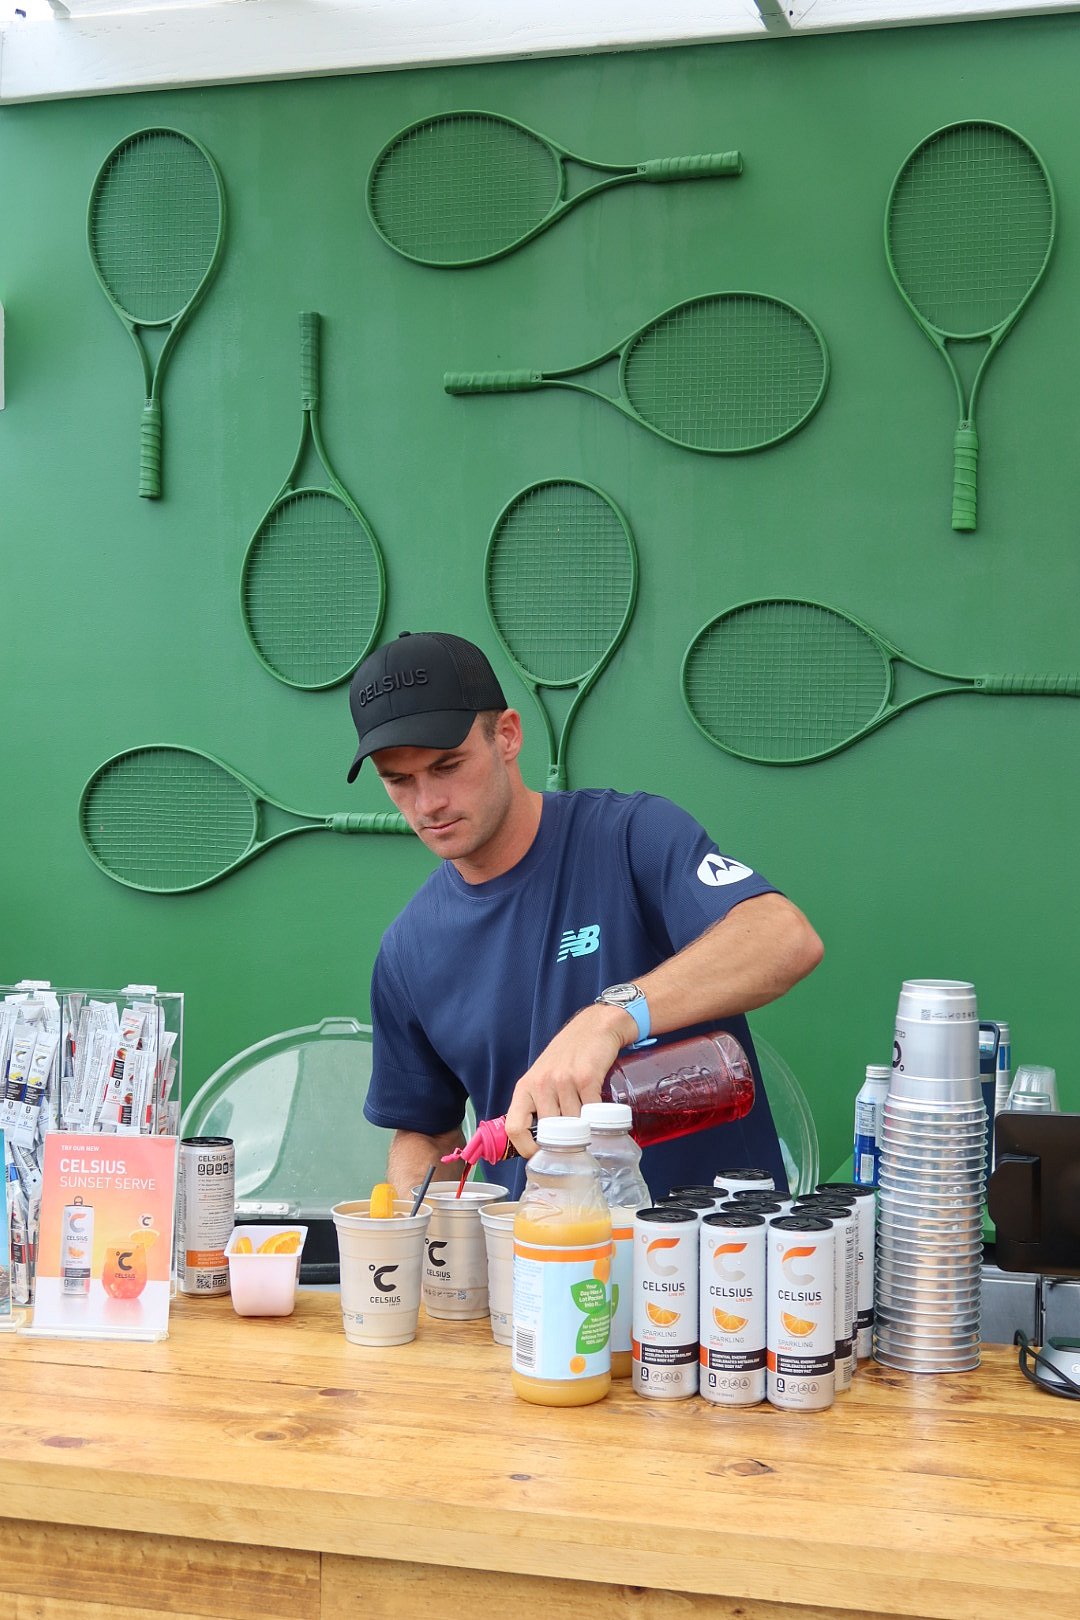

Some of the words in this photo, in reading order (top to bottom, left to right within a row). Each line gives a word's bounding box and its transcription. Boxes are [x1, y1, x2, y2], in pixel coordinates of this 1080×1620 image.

[358, 668, 429, 707] CELSIUS
[198, 1154, 227, 1163] CELSIUS
[60, 1158, 126, 1175] CELSIUS
[60, 1176, 112, 1189] SUNSET
[114, 1177, 156, 1190] SERVE
[426, 1268, 451, 1279] CELSIUS
[642, 1280, 686, 1293] CELSIUS
[709, 1285, 753, 1298] CELSIUS
[369, 1295, 401, 1304] CELSIUS
[777, 1289, 822, 1302] CELSIUS
[642, 1328, 677, 1338] SPARKLING
[709, 1334, 745, 1344] SPARKLING
[777, 1338, 814, 1348] SPARKLING
